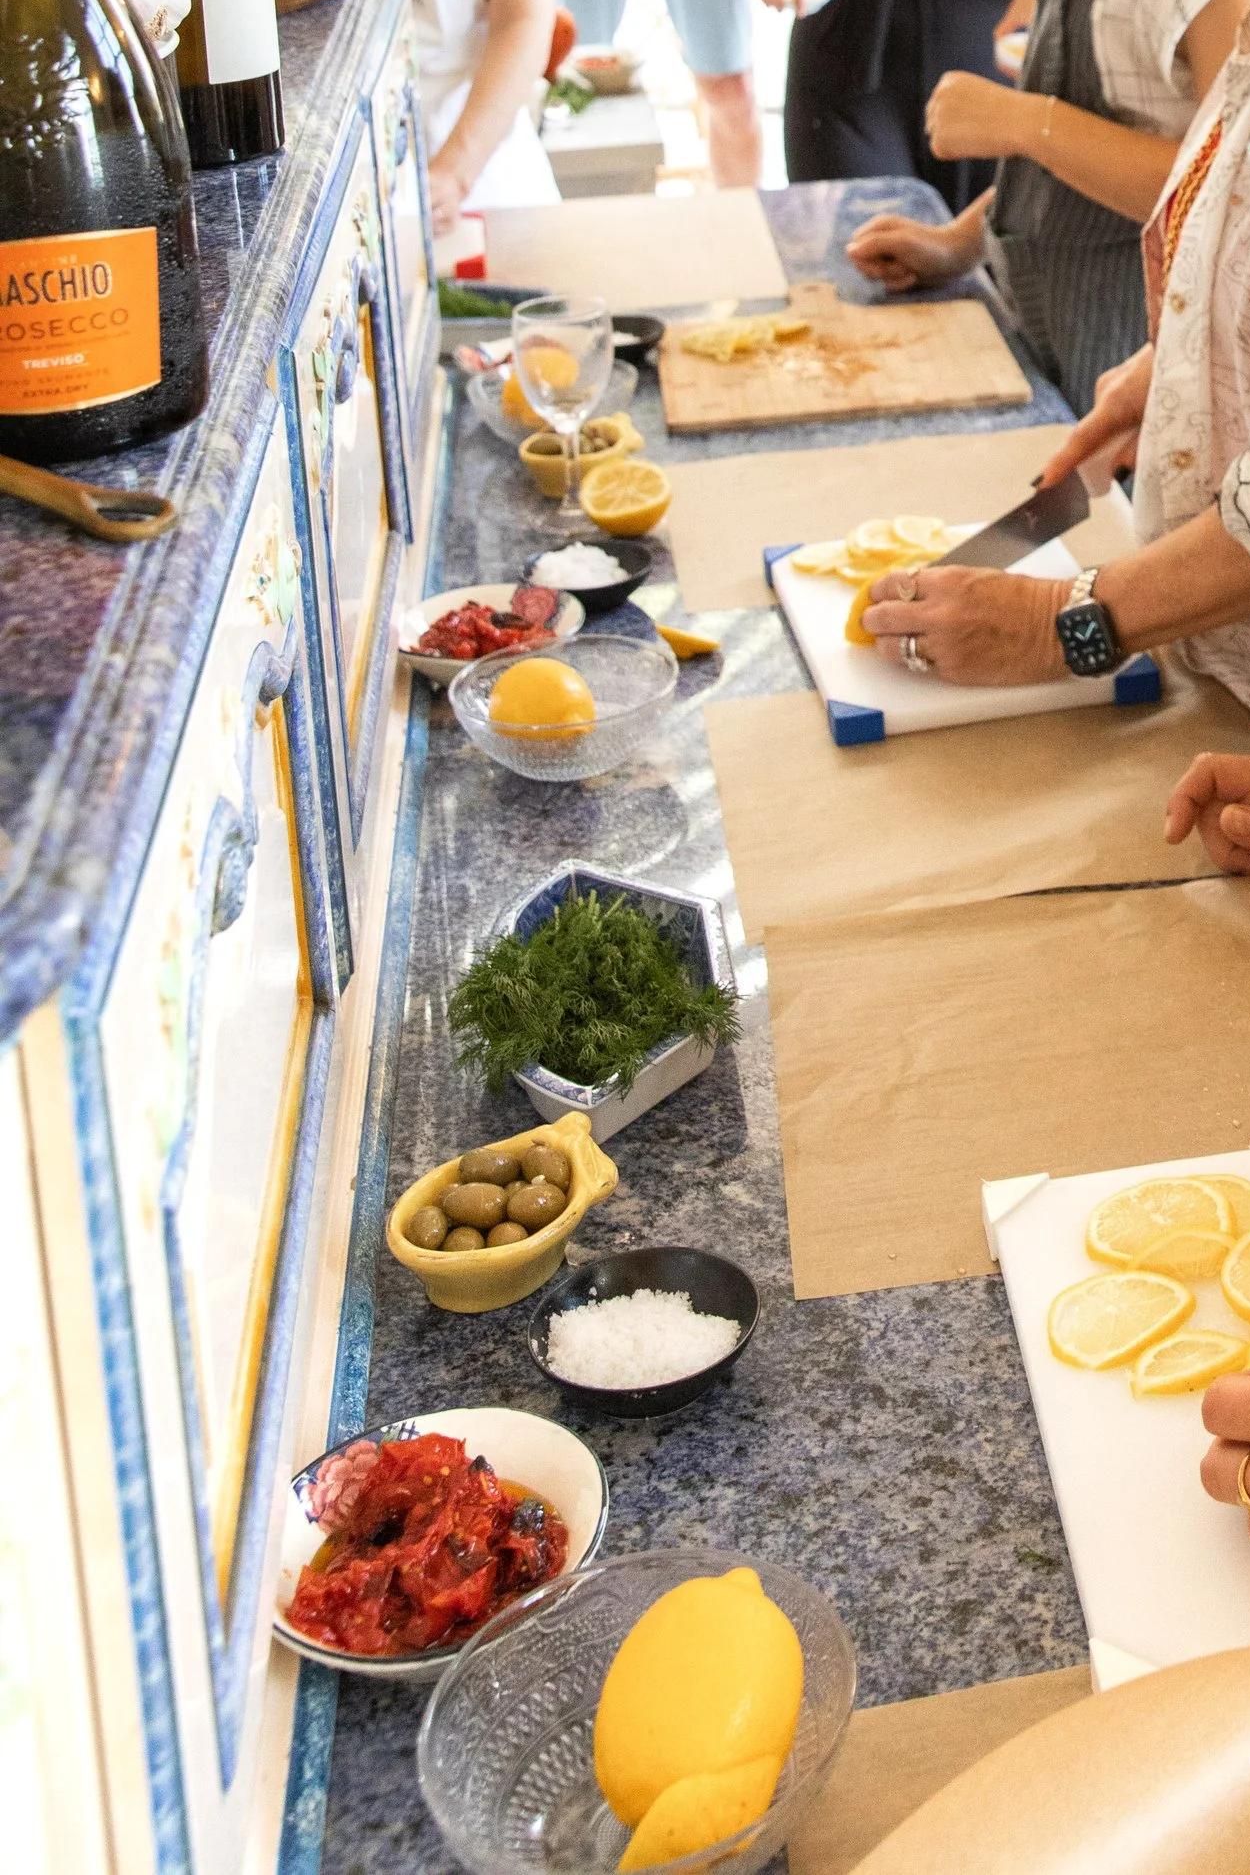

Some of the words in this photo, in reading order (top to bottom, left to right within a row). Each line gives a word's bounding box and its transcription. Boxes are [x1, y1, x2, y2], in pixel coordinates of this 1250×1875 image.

[0, 262, 110, 306] ASCHIO
[0, 308, 129, 341] OSECCO
[22, 353, 85, 370] TREVISO
